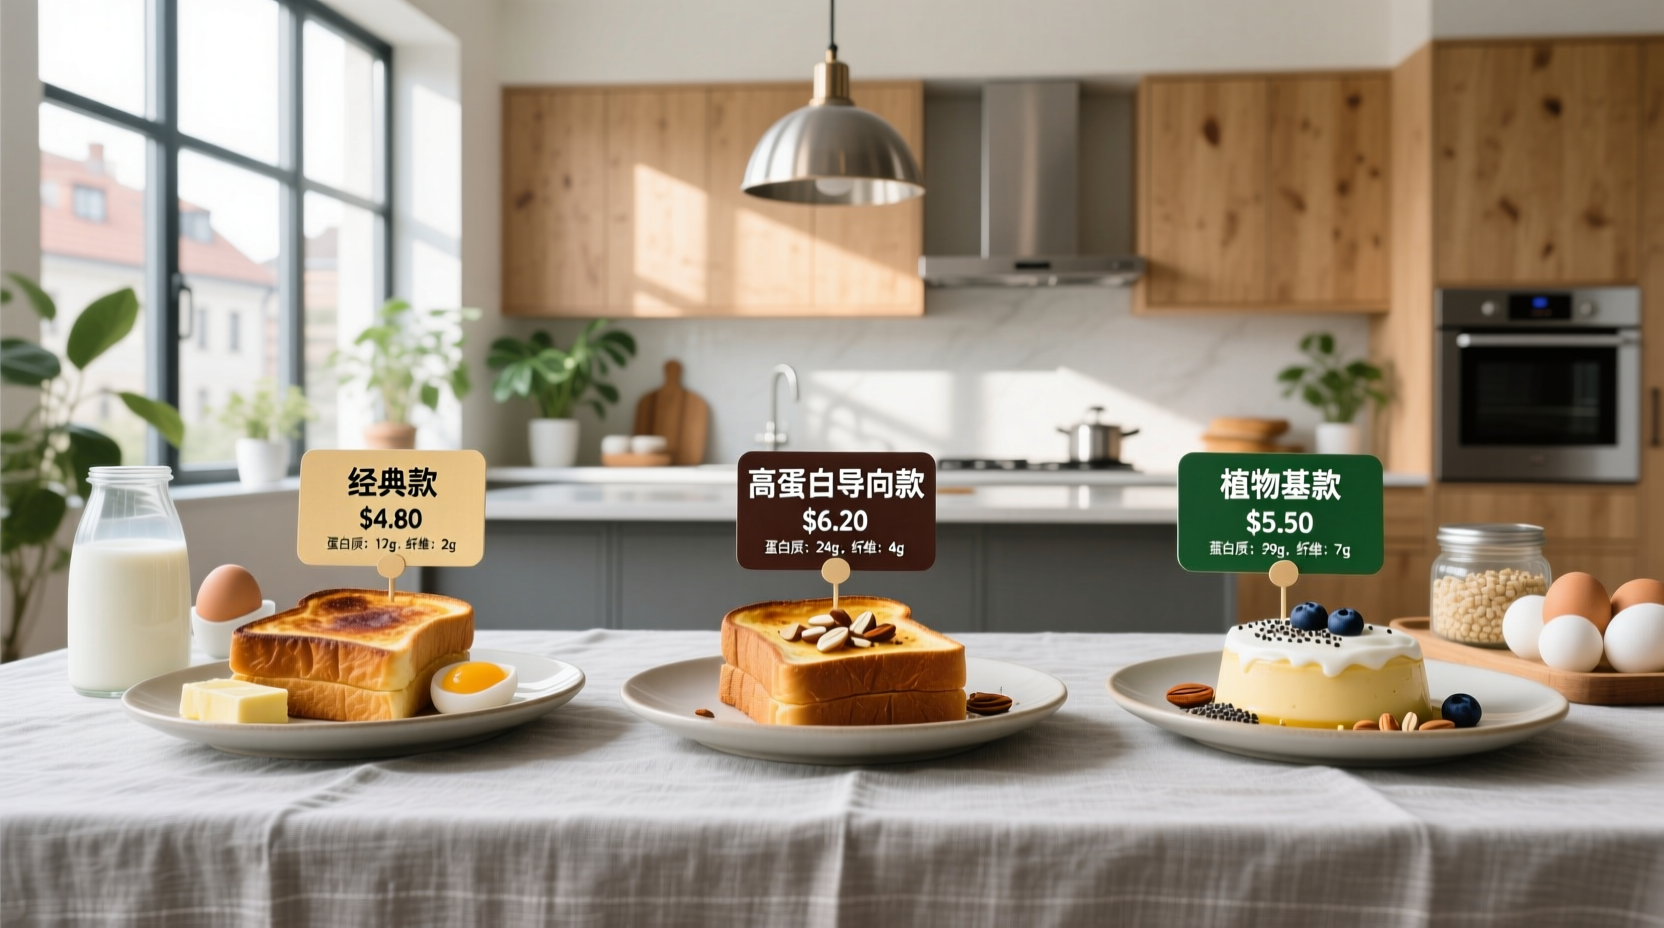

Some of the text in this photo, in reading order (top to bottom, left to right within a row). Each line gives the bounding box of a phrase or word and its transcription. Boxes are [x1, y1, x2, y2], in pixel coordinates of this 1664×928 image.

[347, 467, 438, 498] 经典款
[748, 466, 925, 499] 高蛋白导向款
[1220, 467, 1342, 500] 植物基款
[359, 505, 423, 530] $4.80
[802, 506, 869, 535] $6.20
[1246, 507, 1314, 536] $5.50
